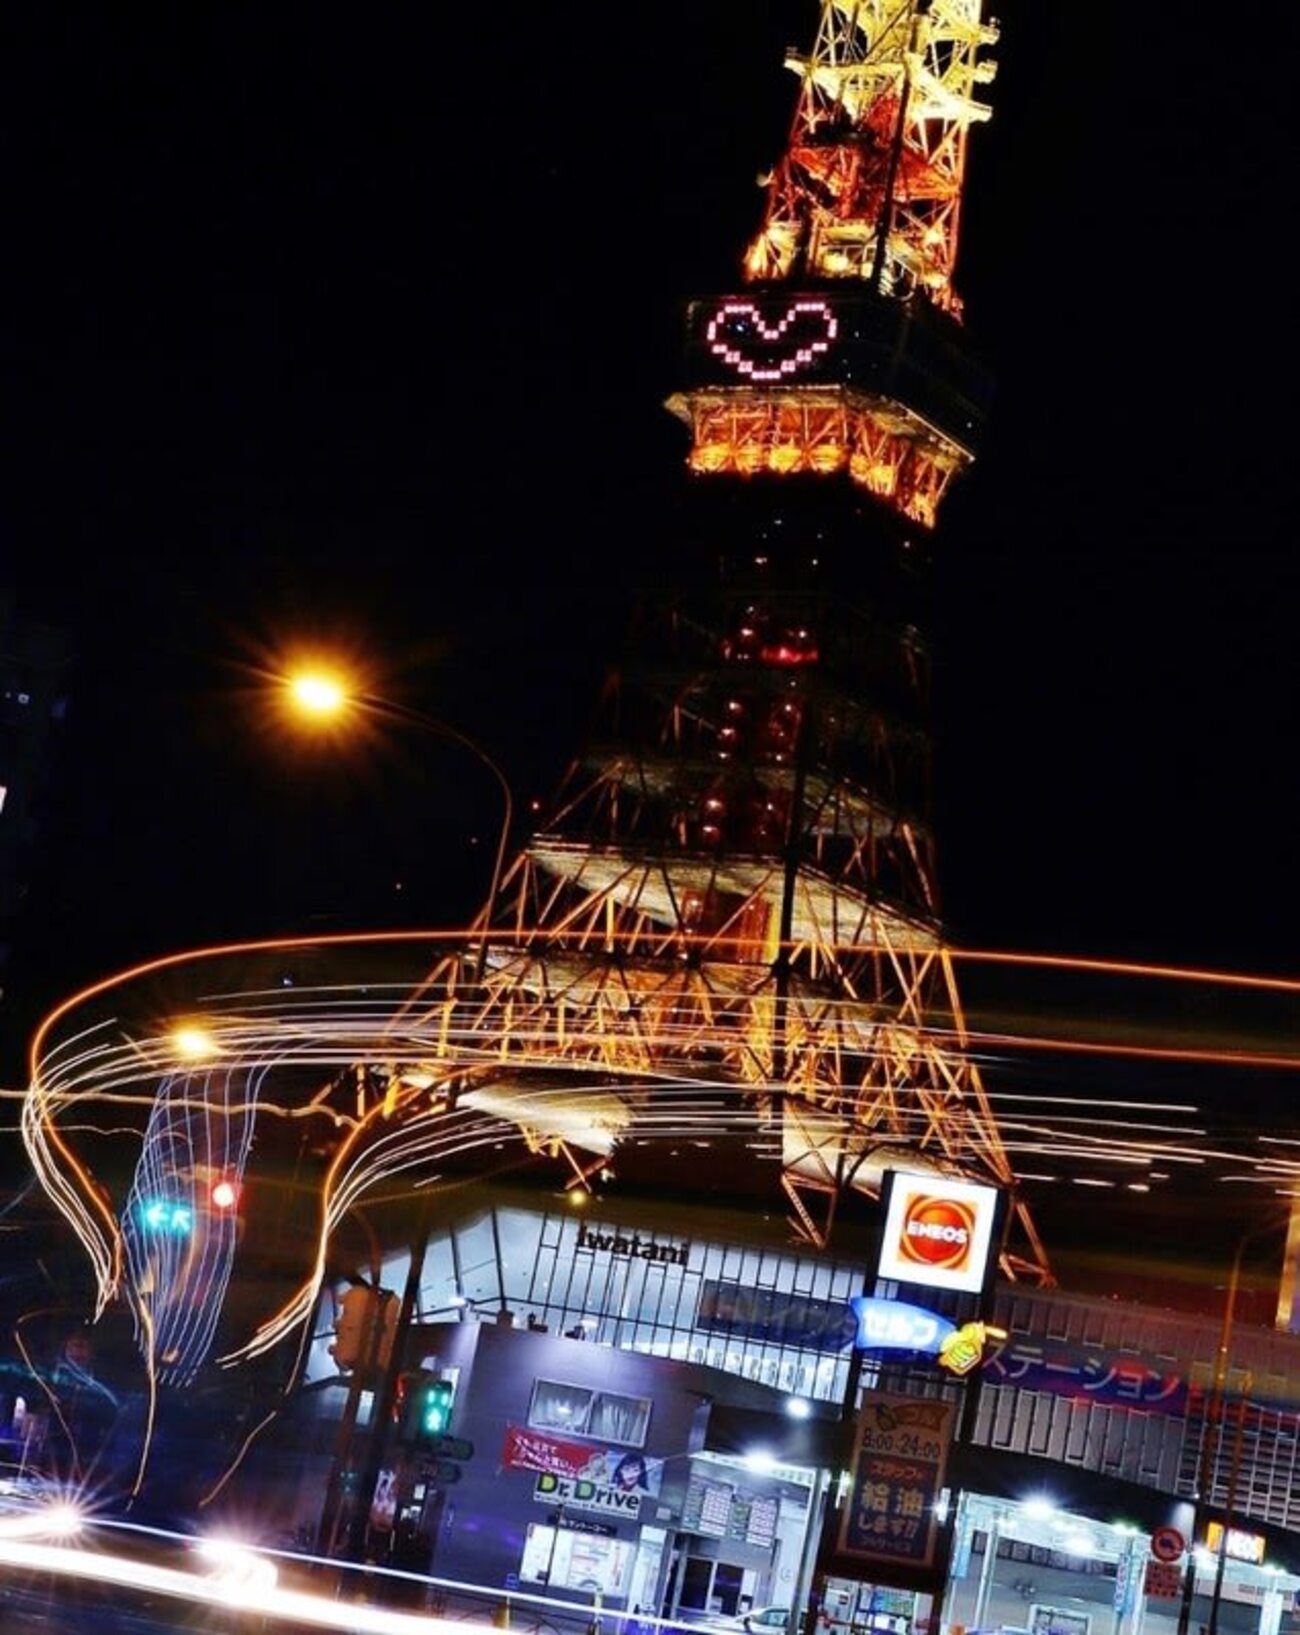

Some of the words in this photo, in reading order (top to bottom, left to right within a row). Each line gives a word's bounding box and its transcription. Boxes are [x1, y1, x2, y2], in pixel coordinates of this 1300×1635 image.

[576, 1224, 690, 1266] Iwatani
[906, 1220, 968, 1244] ENEOS
[982, 1343, 1180, 1400] ステーション
[537, 1471, 570, 1498] Dr.
[574, 1479, 640, 1510] Drive
